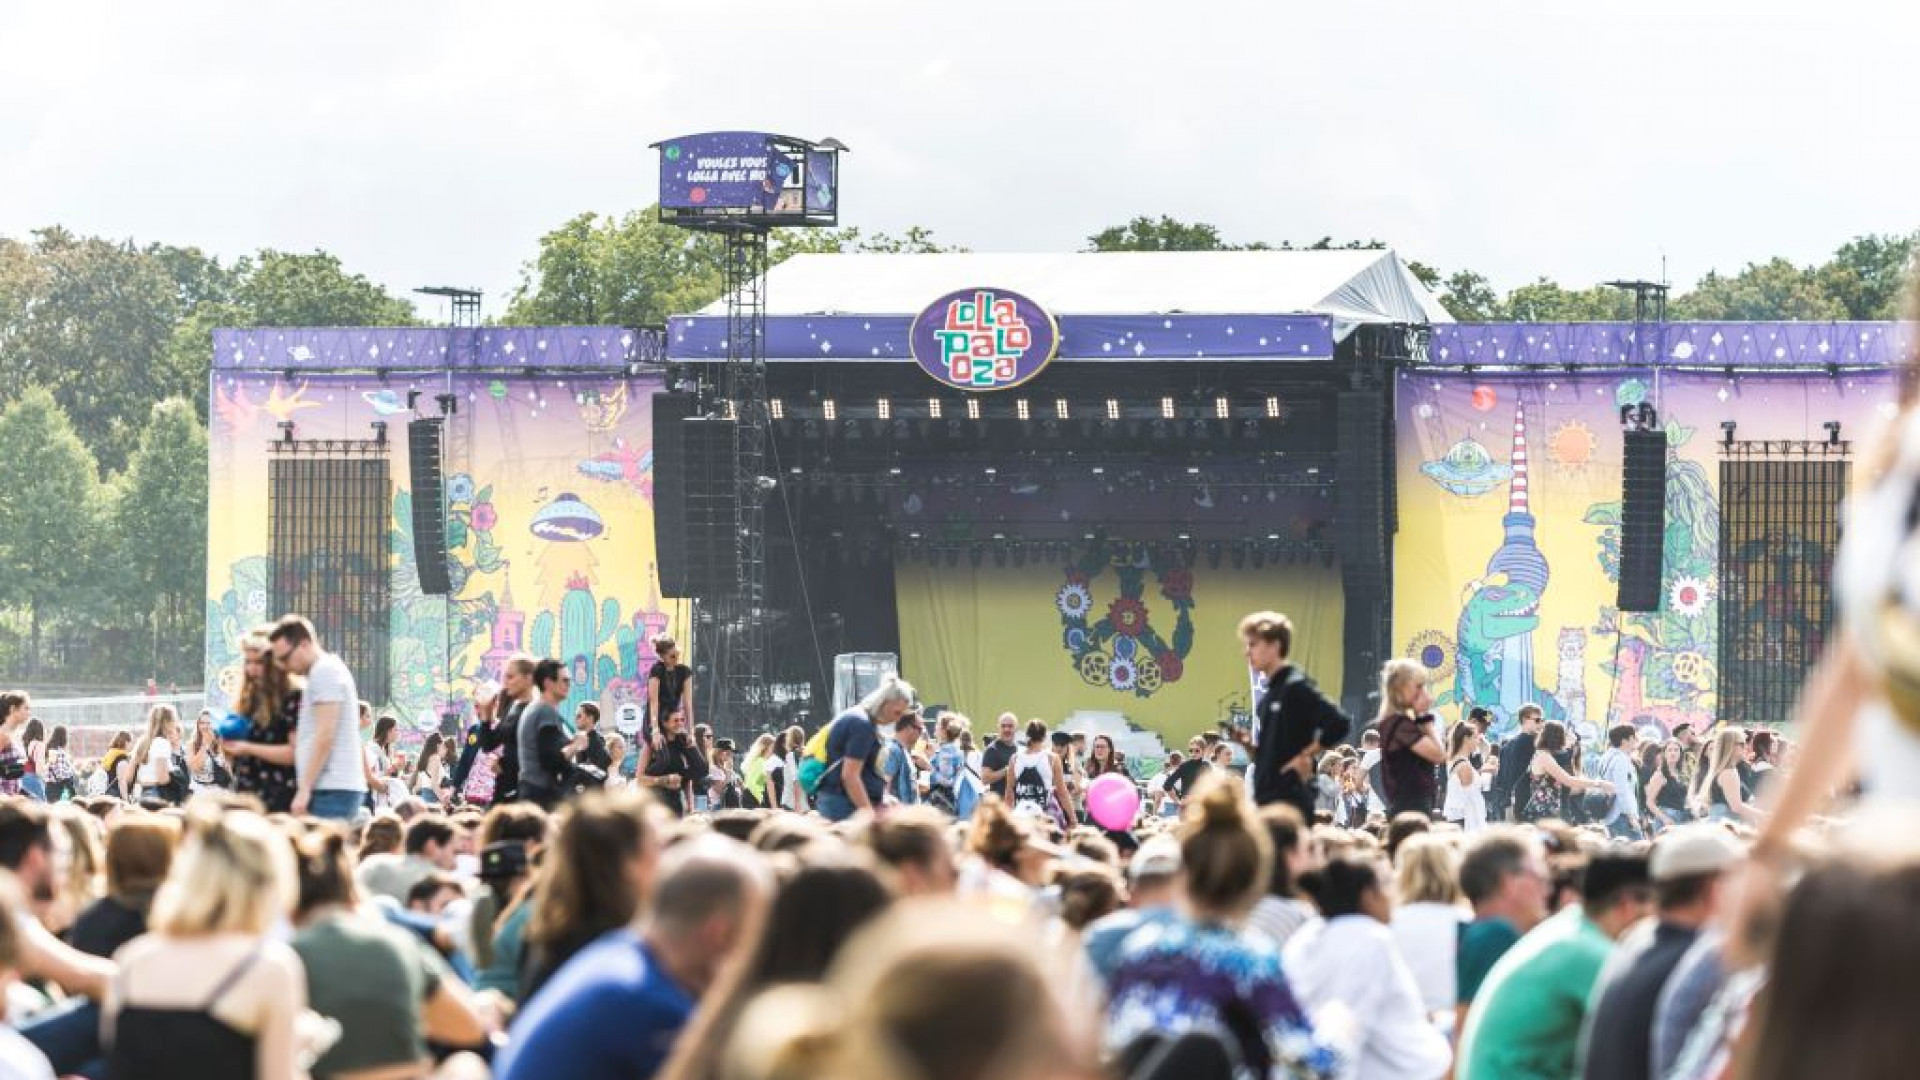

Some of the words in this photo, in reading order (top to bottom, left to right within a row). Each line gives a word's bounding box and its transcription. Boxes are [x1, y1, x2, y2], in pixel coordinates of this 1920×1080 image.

[697, 157, 738, 170] VOULEZ
[740, 156, 768, 168] VOUS
[687, 169, 719, 183] LOLLA
[720, 169, 747, 183] AVEC
